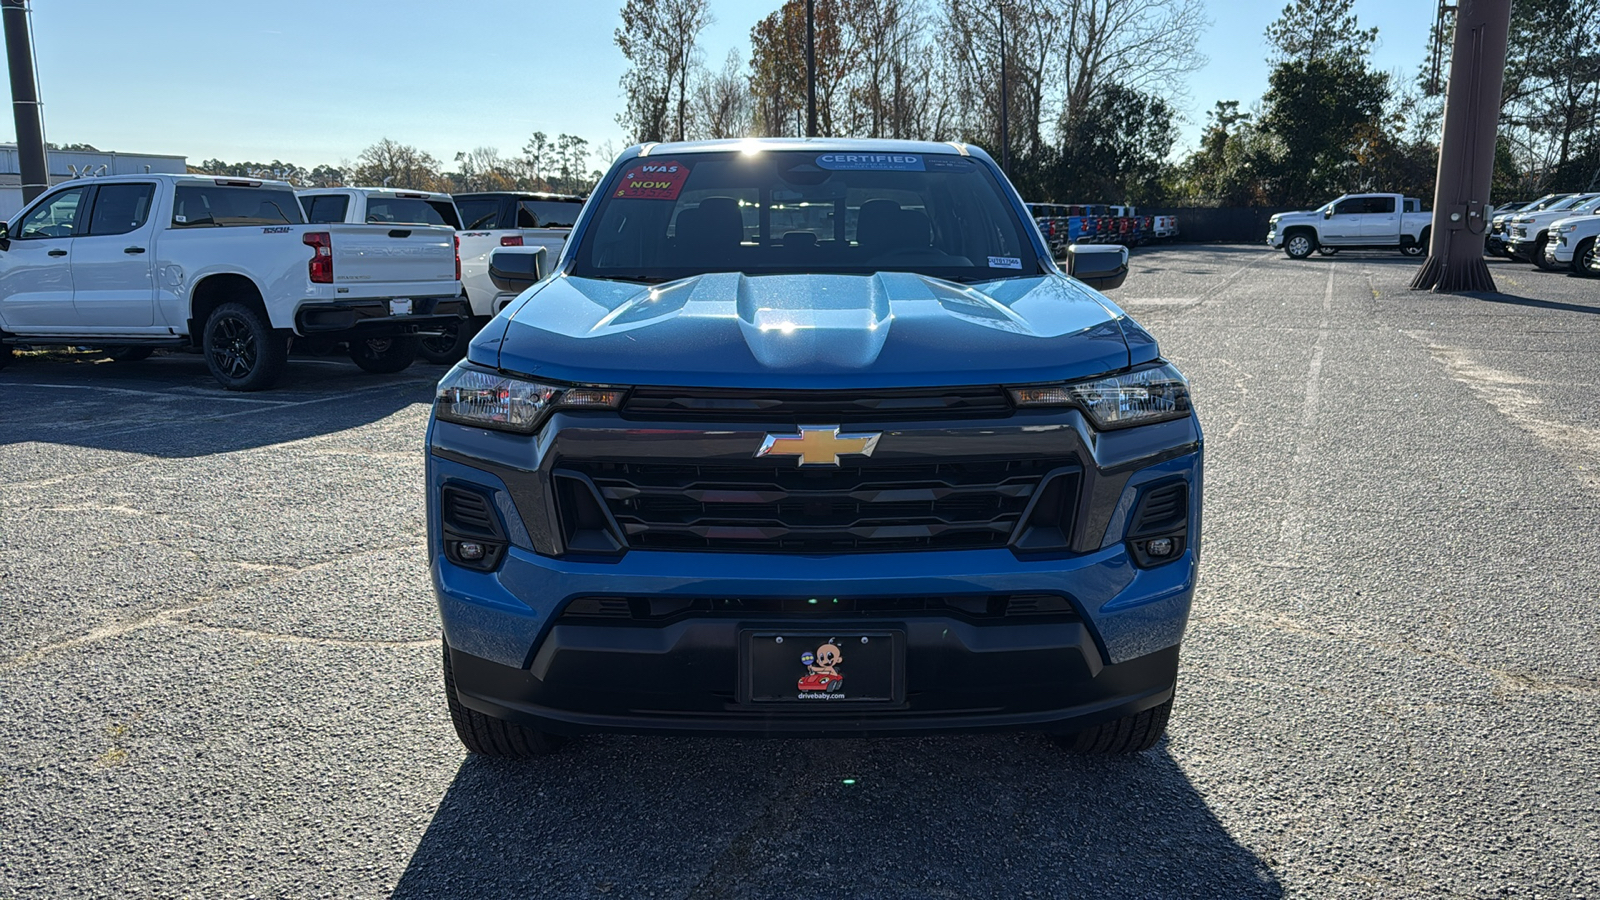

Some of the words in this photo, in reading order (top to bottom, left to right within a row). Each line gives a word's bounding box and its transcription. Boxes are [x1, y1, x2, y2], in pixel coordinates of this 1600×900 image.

[821, 155, 918, 164] CERTIFIED
[626, 172, 635, 180] $
[630, 181, 671, 189] NOW
[617, 189, 625, 197] $
[798, 692, 845, 701] drivebaby.com
